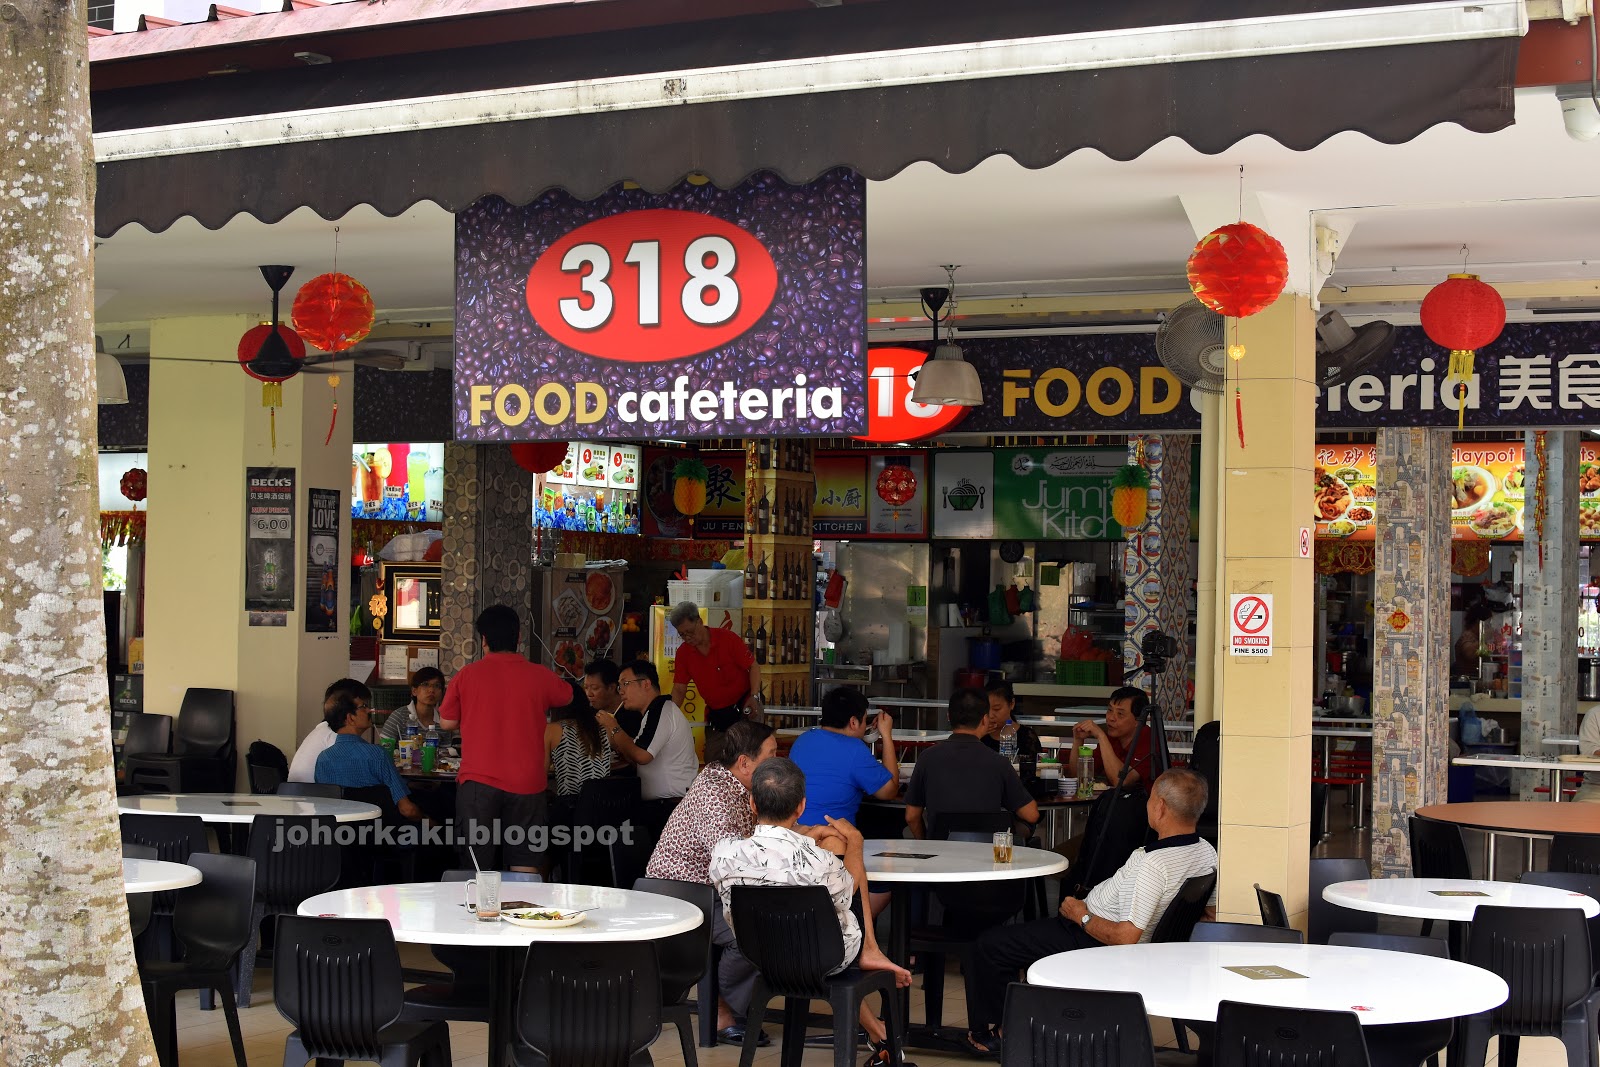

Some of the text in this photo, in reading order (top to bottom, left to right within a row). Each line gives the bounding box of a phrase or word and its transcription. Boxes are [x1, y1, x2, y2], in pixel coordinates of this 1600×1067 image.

[559, 236, 739, 330] 318
[1003, 366, 1182, 417] FOOD
[471, 374, 842, 426] FOOD cafeteria
[252, 478, 291, 487] BECK'S
[313, 499, 336, 509] WHAT WE
[312, 508, 338, 529] LOVE.
[703, 522, 716, 531] JU
[1234, 637, 1268, 645] NO SMOKING
